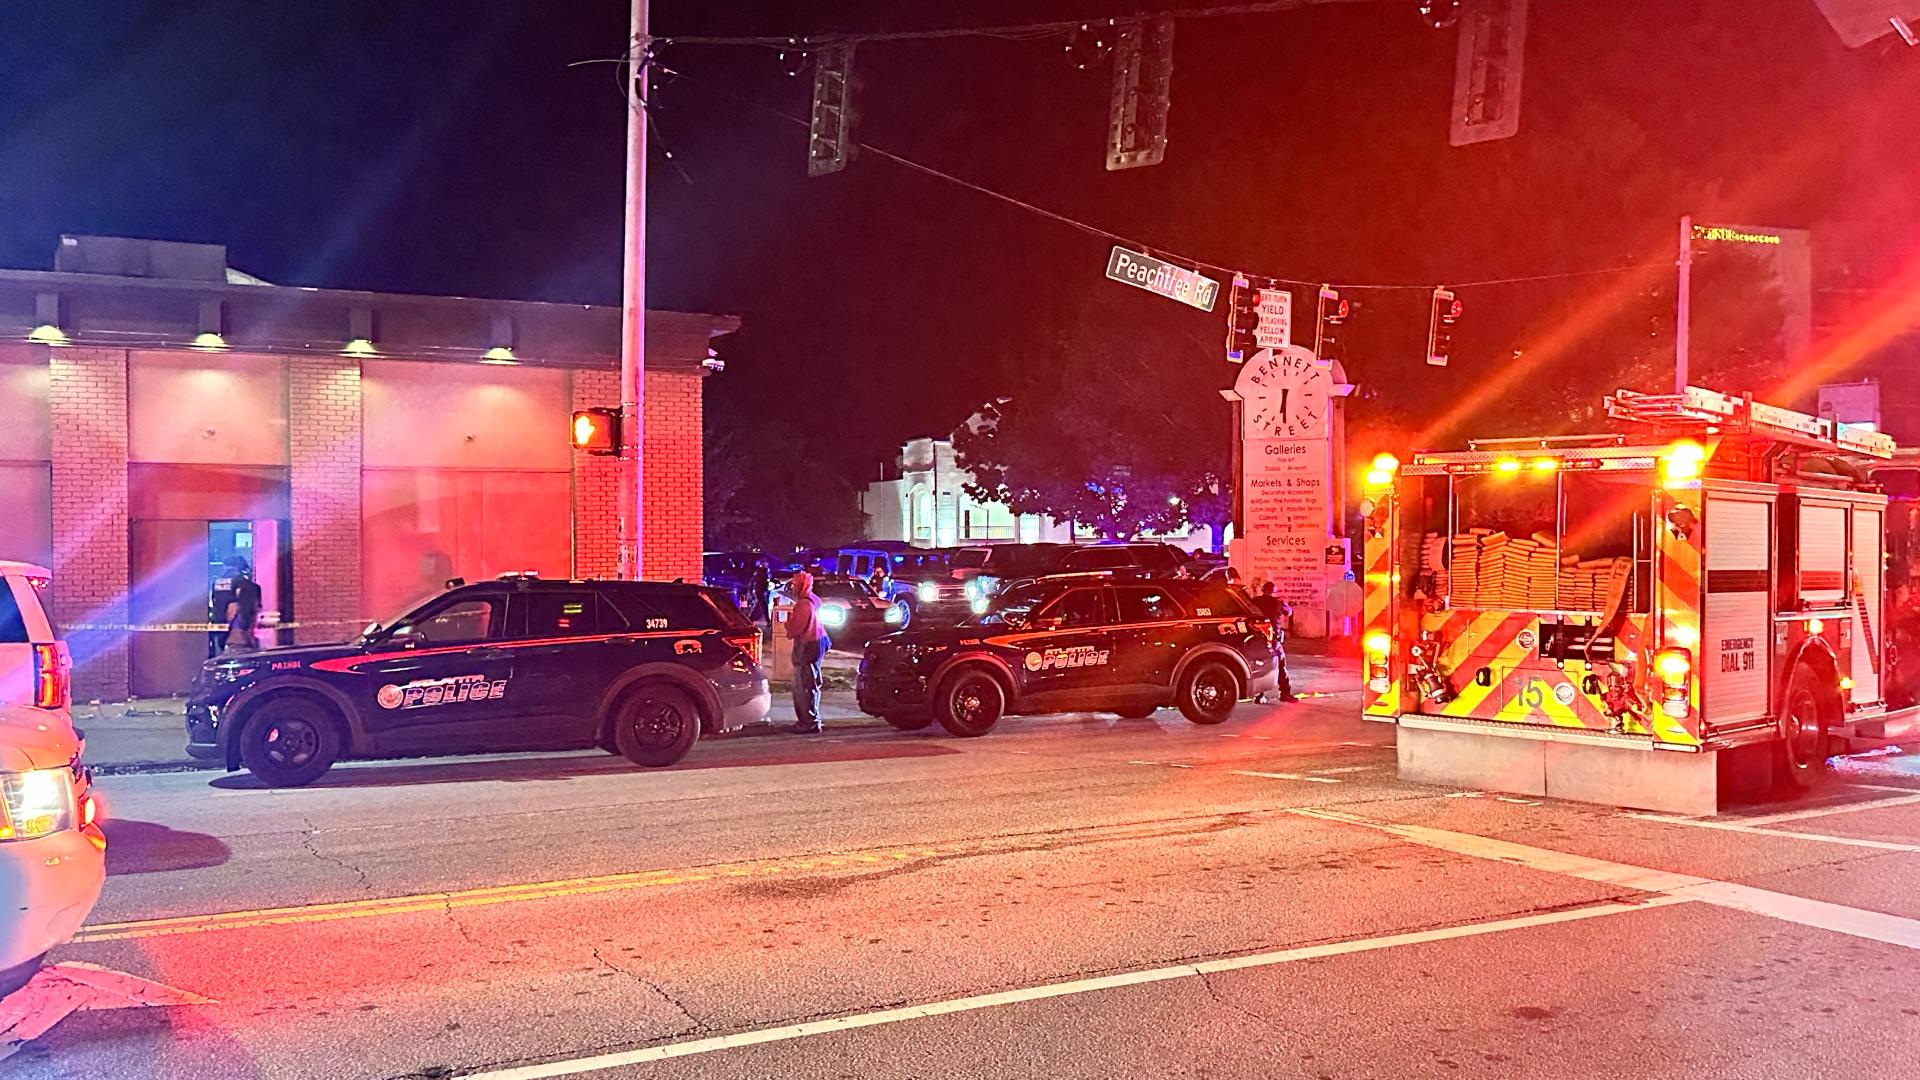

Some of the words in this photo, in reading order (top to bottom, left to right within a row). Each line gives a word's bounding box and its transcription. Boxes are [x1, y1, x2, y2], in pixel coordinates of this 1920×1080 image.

[1114, 253, 1190, 298] Peachtree
[1194, 281, 1213, 306] Rd
[1262, 304, 1284, 315] YIELD
[1260, 326, 1285, 335] YELLOW
[1259, 335, 1283, 345] ARROW
[1250, 355, 1320, 385] BENNETT
[1253, 411, 1318, 437] STREET
[1264, 444, 1307, 456] Galleries
[1250, 479, 1282, 488] Markets
[1286, 478, 1293, 487] &
[1296, 478, 1321, 489] Shops
[1266, 535, 1306, 546] Services
[646, 618, 668, 630] 34739
[1041, 649, 1110, 670] POLICE
[1721, 652, 1740, 673] DIAL
[1743, 651, 1754, 671] 911
[402, 679, 508, 707] POLICE
[1513, 676, 1543, 709] 15
